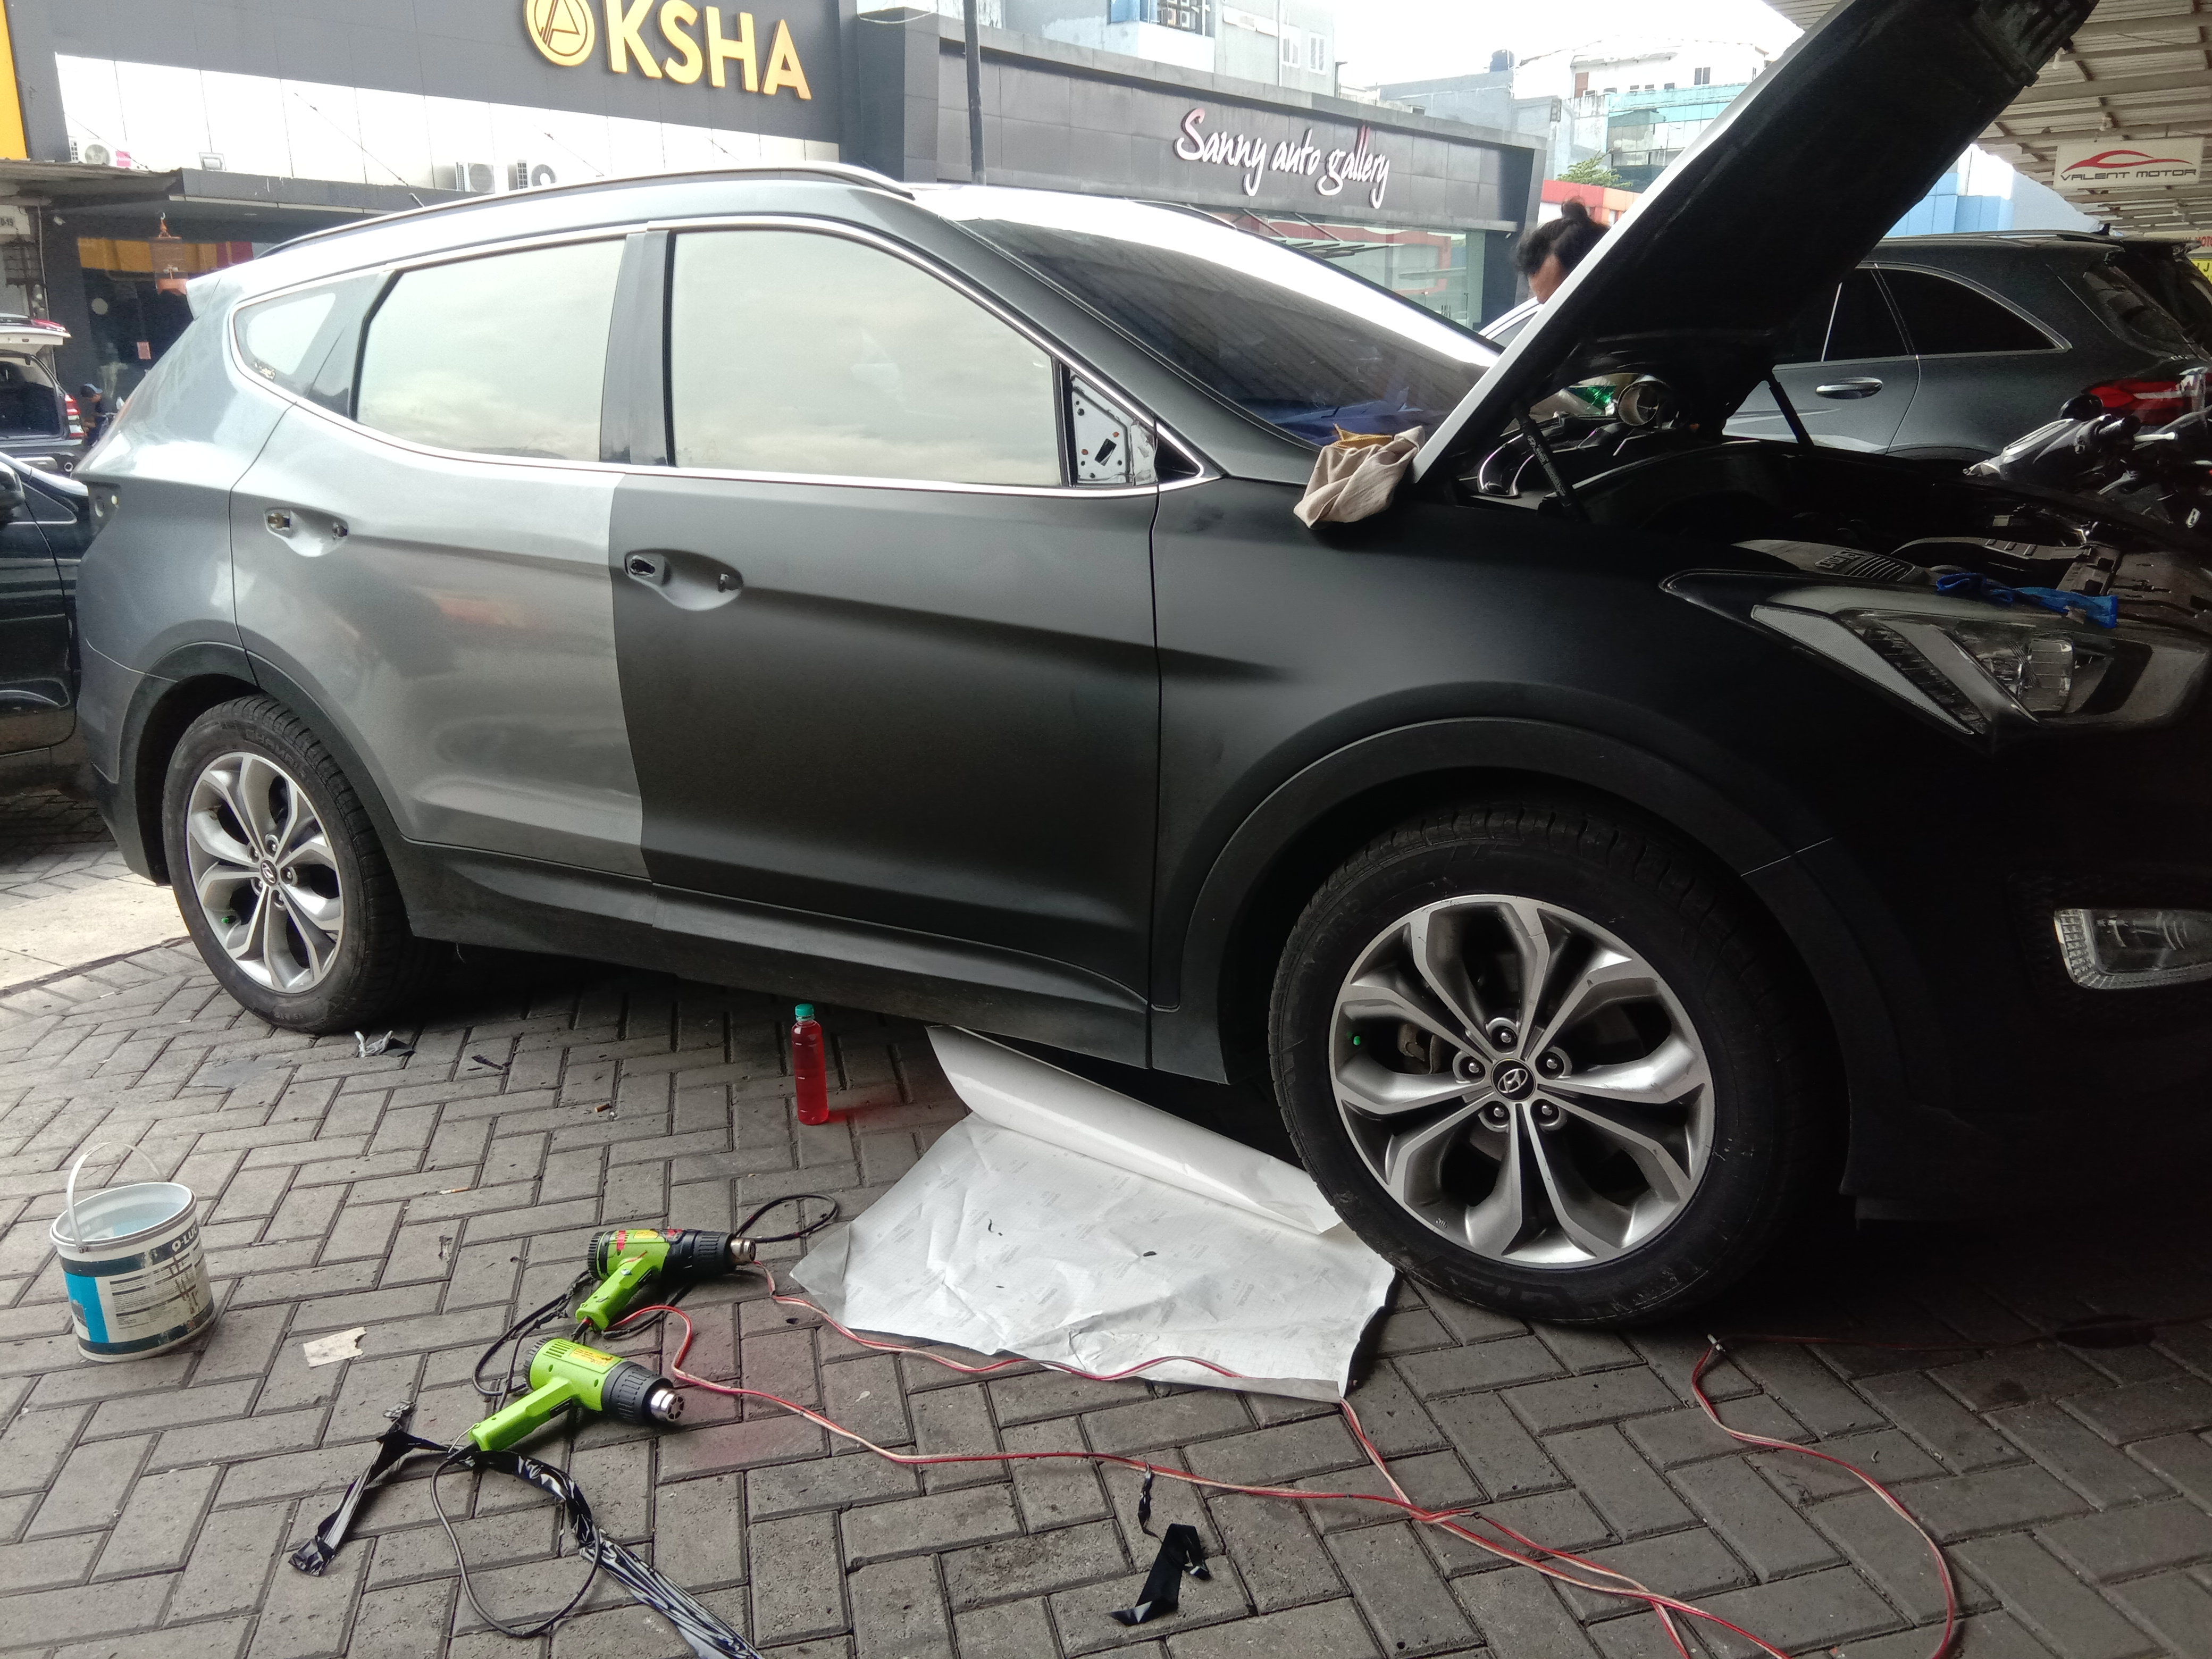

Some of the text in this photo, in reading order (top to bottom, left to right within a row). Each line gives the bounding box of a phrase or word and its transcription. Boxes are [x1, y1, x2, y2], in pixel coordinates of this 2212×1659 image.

[1175, 108, 1390, 209] Sanny auto gallery
[2060, 169, 2197, 181] VALENT MOTOR
